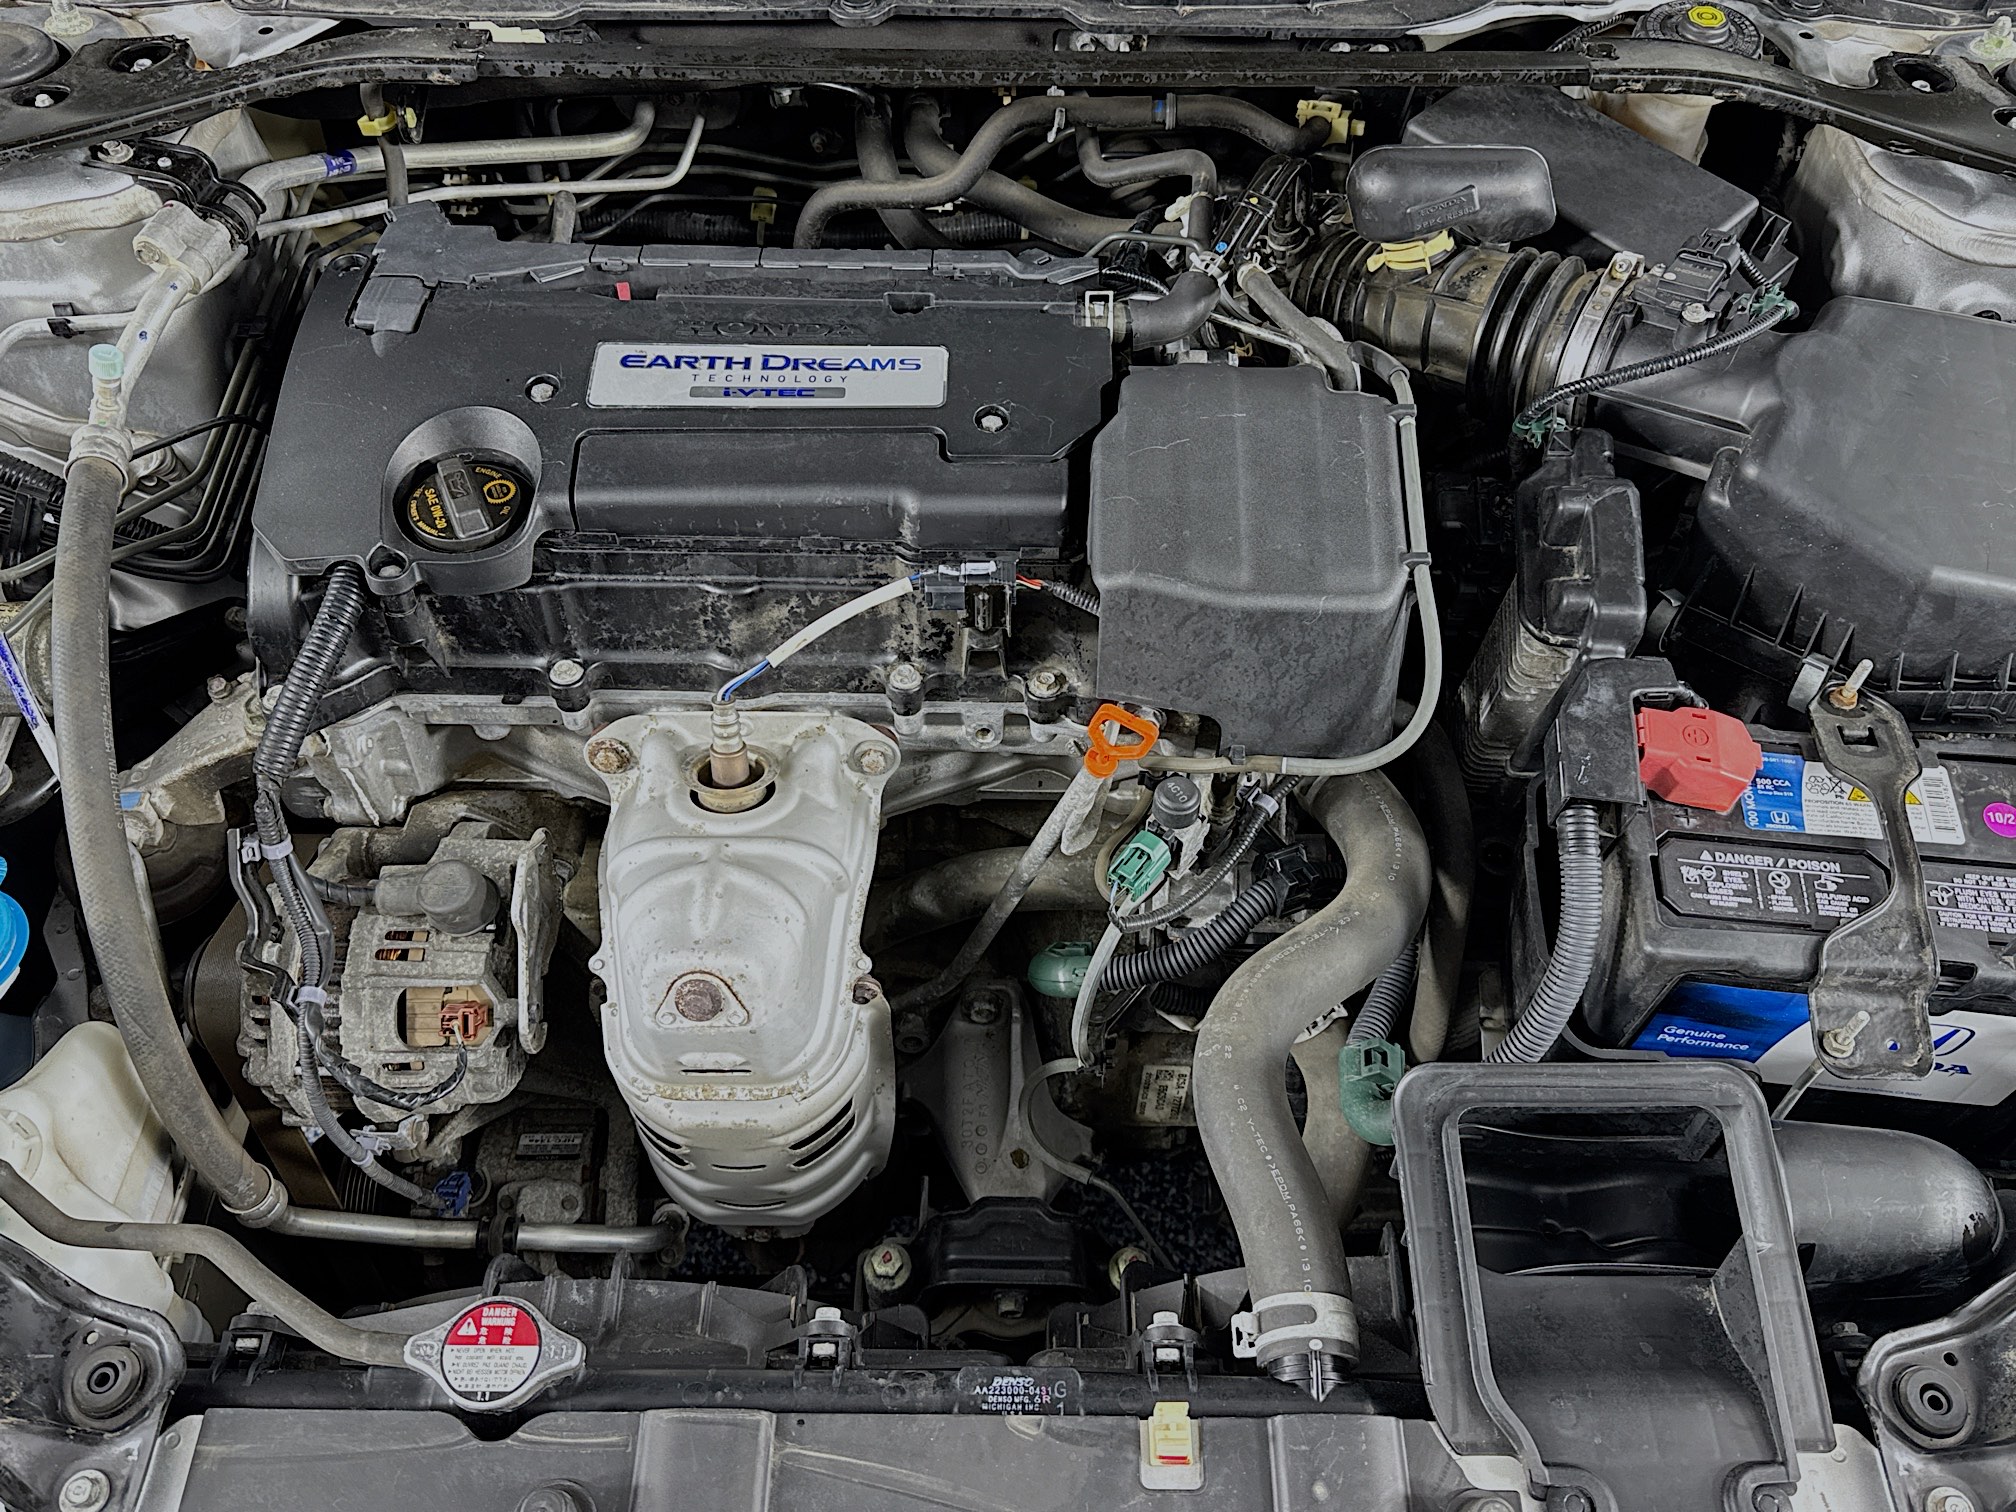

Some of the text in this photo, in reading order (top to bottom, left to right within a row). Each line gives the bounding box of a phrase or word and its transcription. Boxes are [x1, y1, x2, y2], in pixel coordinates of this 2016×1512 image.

[676, 320, 867, 338] HONDA
[619, 354, 922, 371] EARTH DREAMS
[692, 374, 848, 383] TECHNOLOGY
[723, 387, 816, 397] i-VTEC
[475, 466, 502, 479] ENGINE
[424, 488, 448, 529] SAE 0W-20
[500, 505, 511, 516] OIL
[1756, 778, 1791, 787] 500 CCA
[1167, 782, 1188, 802] 4C10
[1748, 812, 1759, 826] 100
[1987, 811, 2016, 825] 10/2
[1714, 852, 1841, 873] DANGER / POISON
[1722, 870, 1749, 878] SHIELD
[1707, 881, 1748, 890] EXPLOSIVE
[1964, 878, 1976, 886] NOT
[1954, 887, 1978, 897] FLUSH
[1980, 889, 1998, 898] EYES
[1815, 893, 1870, 904] SULFURIC ACID
[1955, 894, 1976, 903] WITH
[1957, 902, 1990, 912] MEDICAL
[1991, 904, 2010, 913] HELP
[1663, 1025, 1726, 1040] Genuine
[1657, 1033, 1749, 1051] Performance
[1246, 1118, 1269, 1154] Y-TEC
[1301, 1257, 1311, 1272] 13
[482, 1307, 518, 1317] DANGER
[481, 1317, 516, 1326] WARNING
[992, 1376, 1035, 1387] DENSO
[974, 1386, 1052, 1395] AA223000-0431
[1054, 1381, 1067, 1398] G
[476, 1391, 490, 1401] 1.1
[981, 1403, 1022, 1411] MICHIGAN
